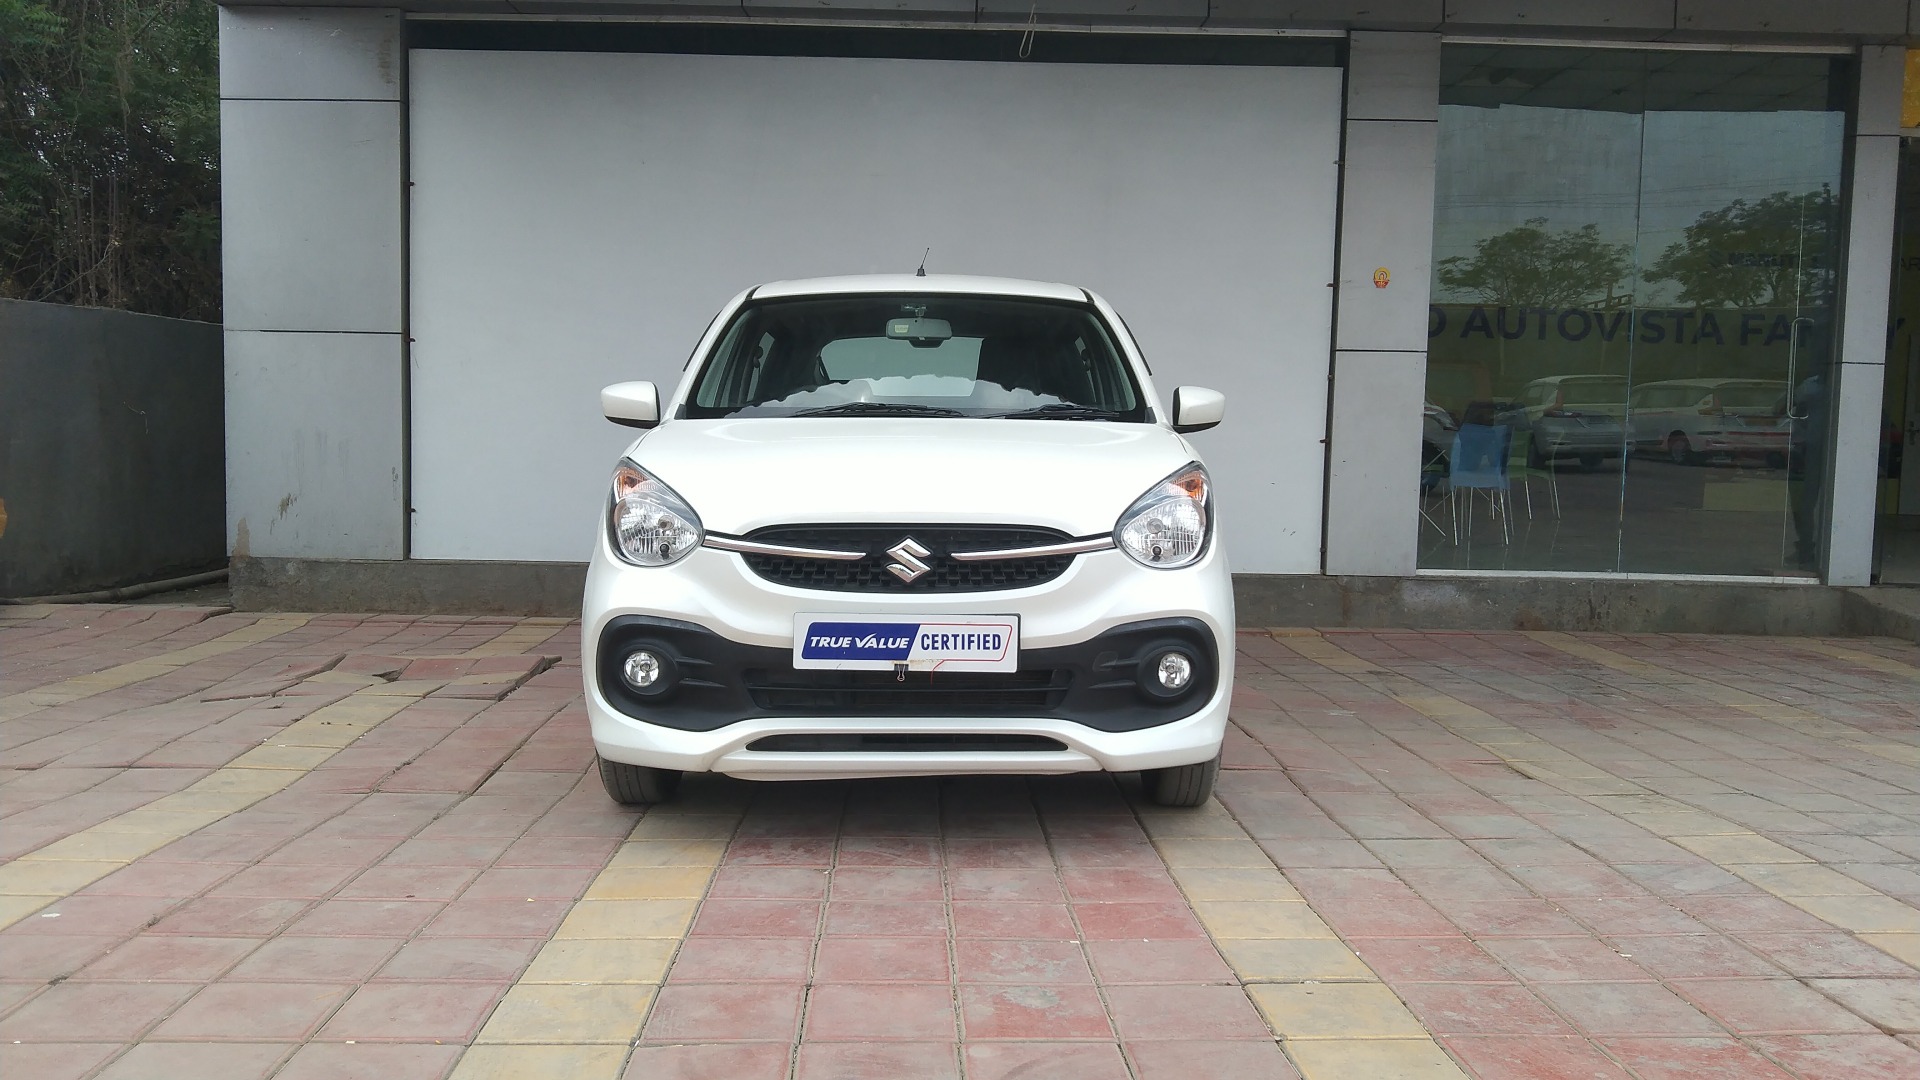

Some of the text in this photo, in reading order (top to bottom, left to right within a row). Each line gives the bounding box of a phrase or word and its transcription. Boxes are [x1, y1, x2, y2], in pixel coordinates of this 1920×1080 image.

[1459, 306, 1725, 345] AUTOVISTA
[810, 633, 1001, 650] TRUE VALUE CERTIFIED
